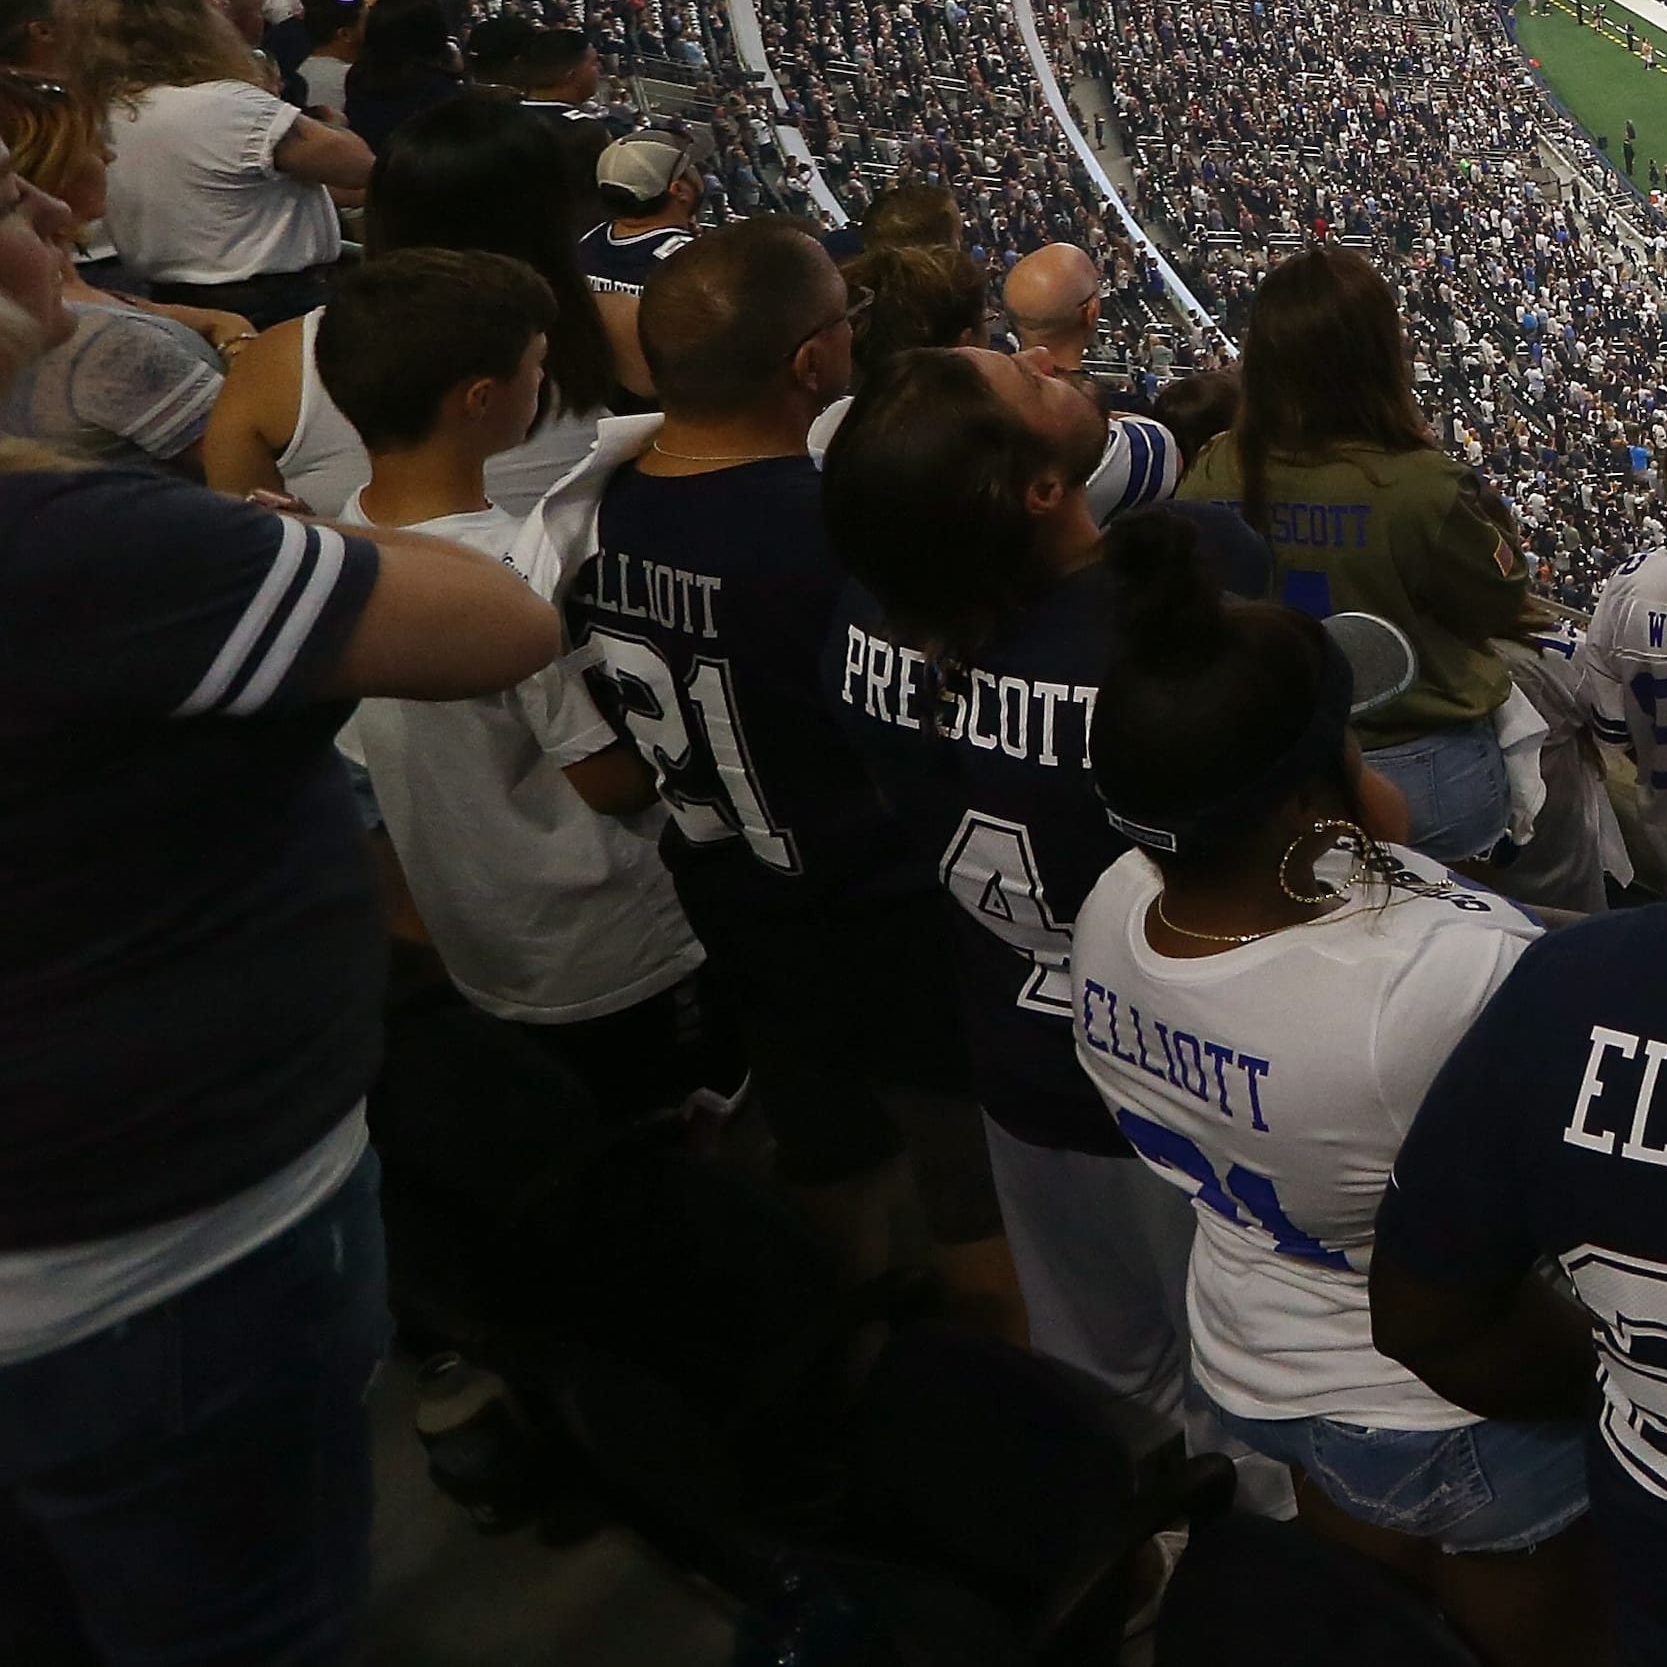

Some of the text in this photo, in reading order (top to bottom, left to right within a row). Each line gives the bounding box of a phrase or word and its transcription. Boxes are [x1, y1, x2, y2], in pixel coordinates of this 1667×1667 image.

[571, 622, 803, 877] 21
[938, 809, 1075, 1016] 4
[1084, 978, 1270, 1133] ELLIOTT
